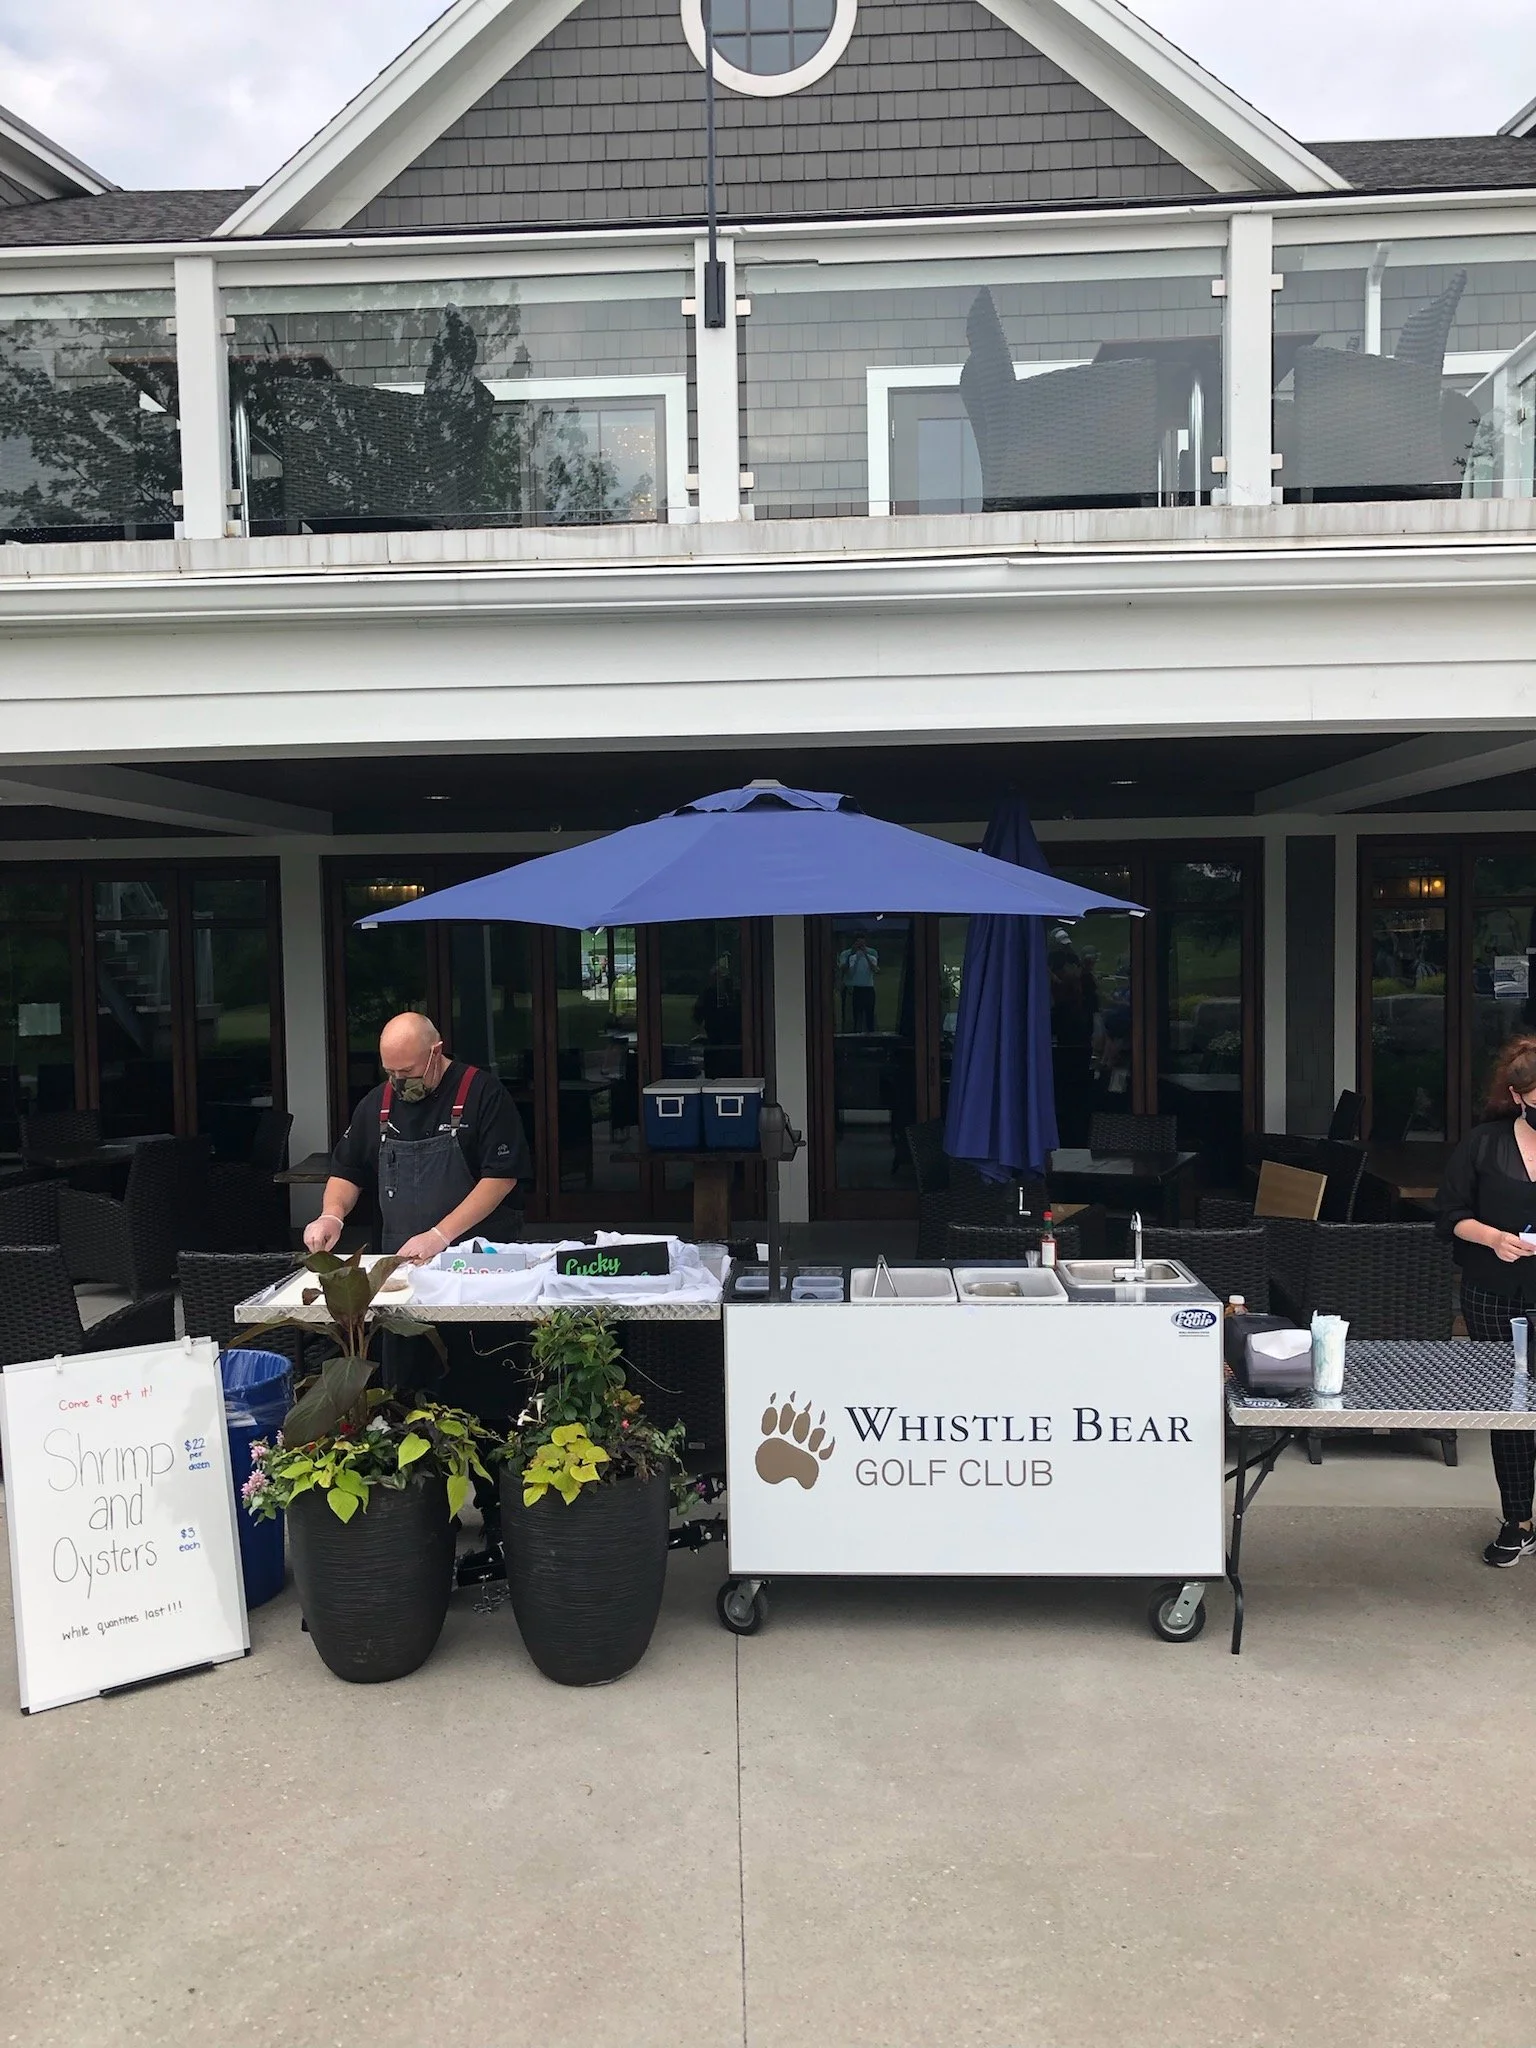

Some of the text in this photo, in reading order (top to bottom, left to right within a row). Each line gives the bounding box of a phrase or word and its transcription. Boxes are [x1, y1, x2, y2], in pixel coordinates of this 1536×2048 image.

[565, 1252, 621, 1276] Lucky
[1176, 1318, 1214, 1327] EQUIP
[58, 1399, 90, 1411] Come
[110, 1389, 132, 1409] get
[140, 1385, 153, 1399] it!
[844, 1406, 1193, 1442] WHISTLE BEAR
[184, 1437, 206, 1452] $22
[43, 1428, 174, 1492] Shrimp
[189, 1451, 202, 1460] per
[188, 1461, 211, 1471] dozen
[855, 1458, 1053, 1487] GOLF CLUB
[88, 1483, 143, 1531] and
[180, 1527, 196, 1539] $3
[178, 1541, 201, 1553] each
[53, 1536, 158, 1599] Oysters
[61, 1625, 90, 1641] while
